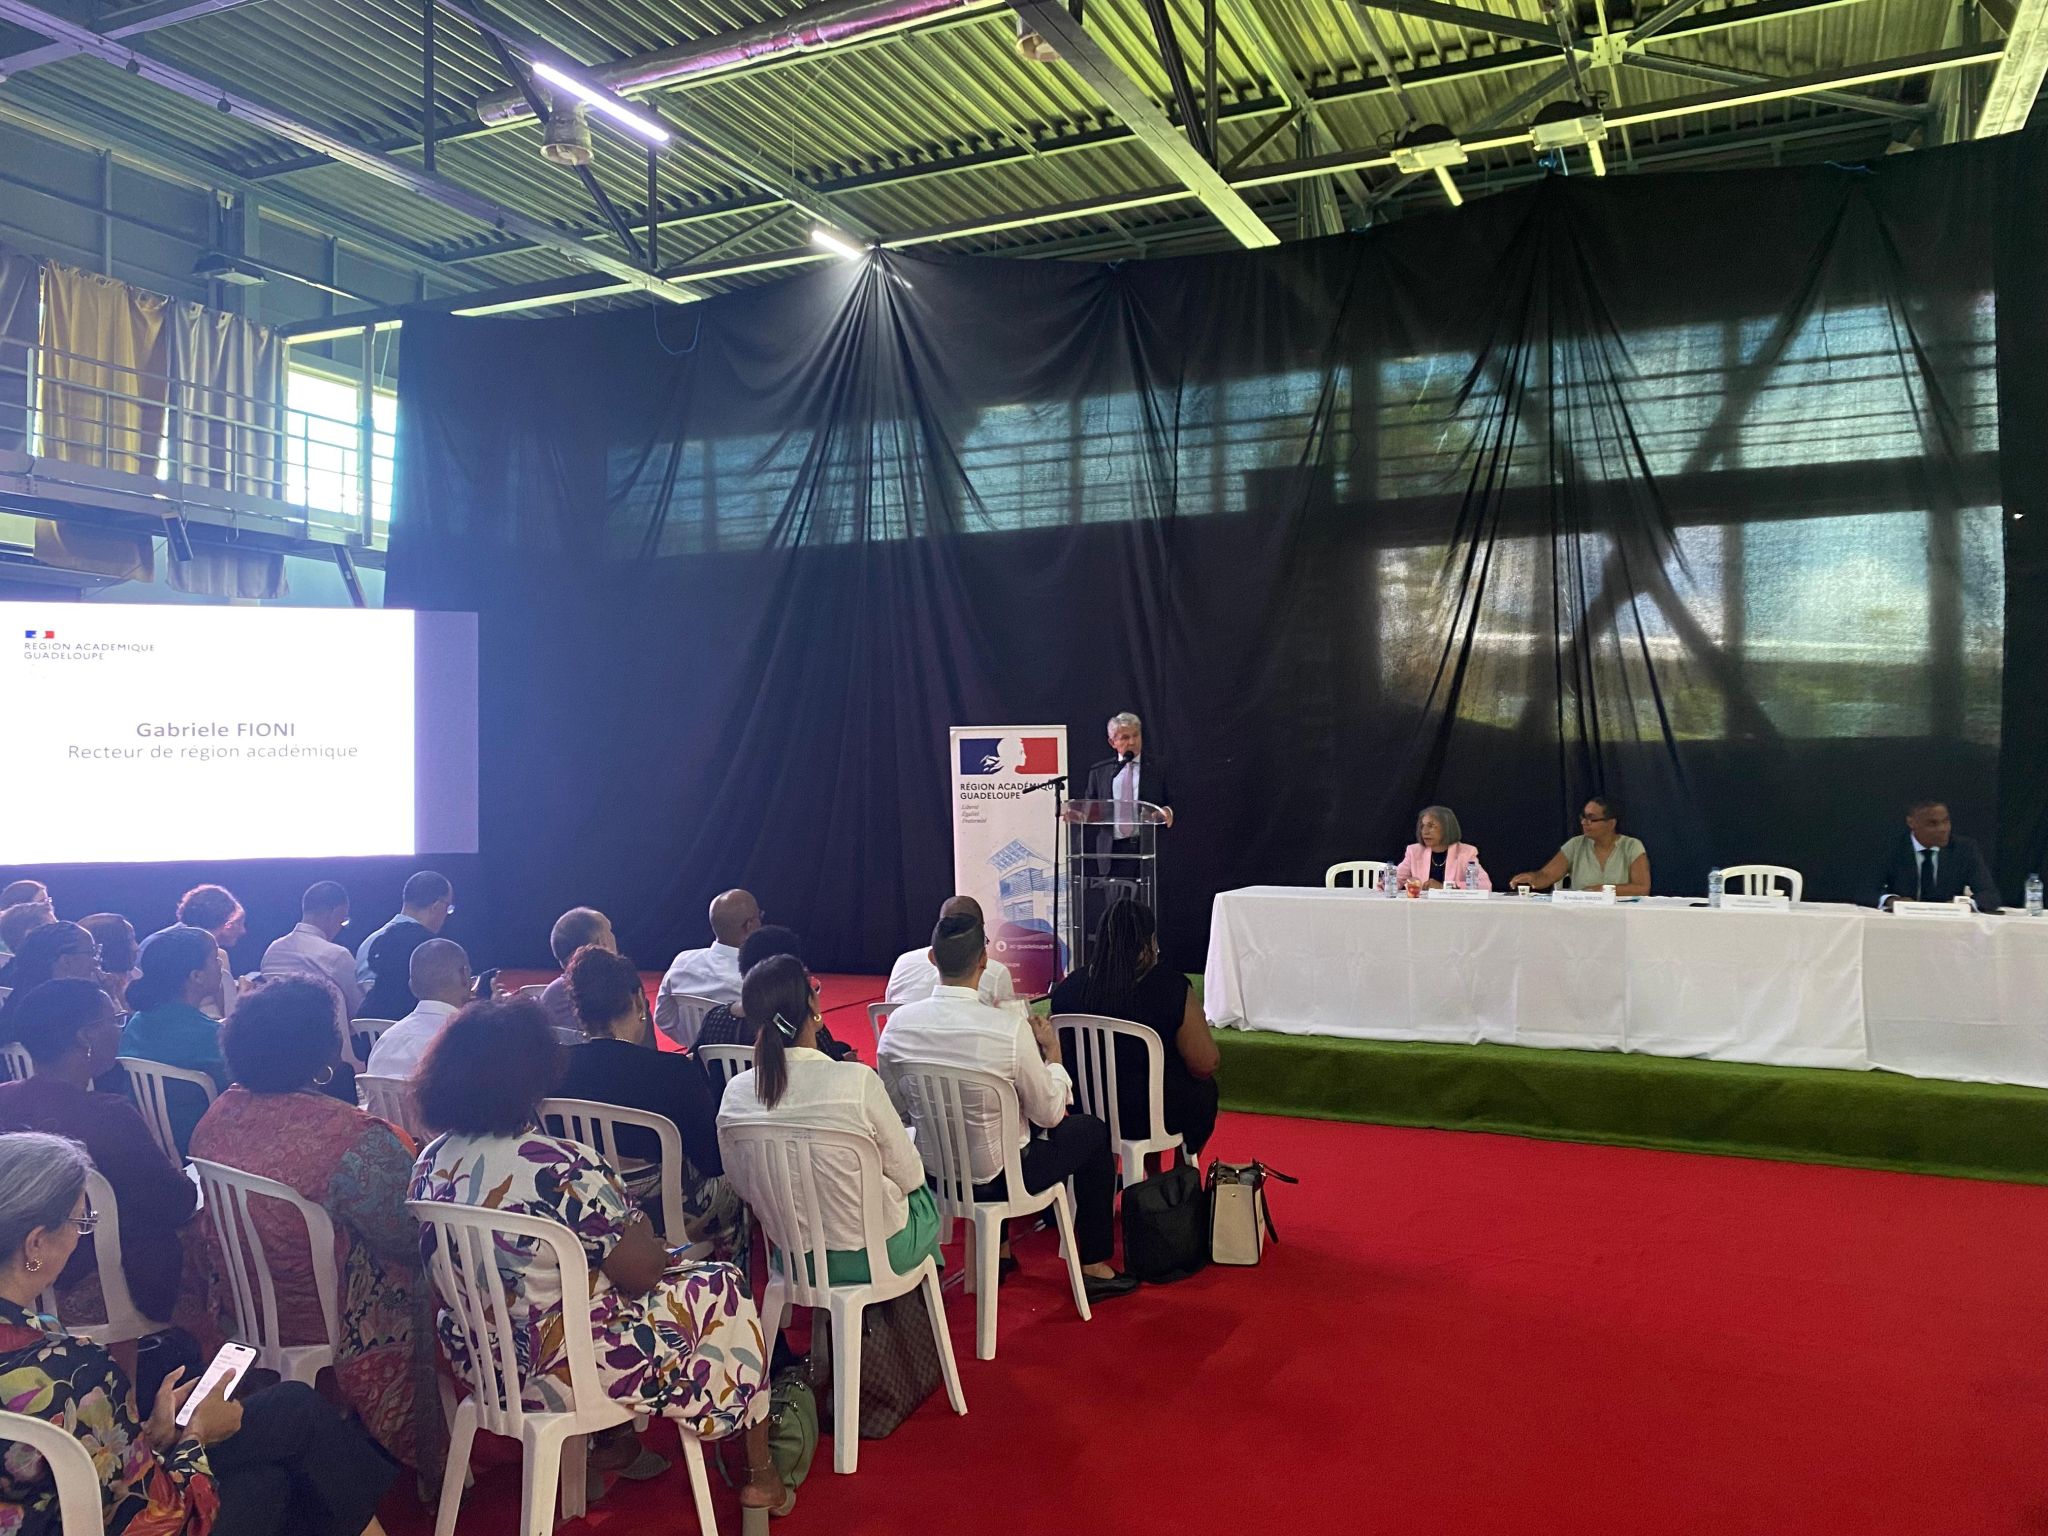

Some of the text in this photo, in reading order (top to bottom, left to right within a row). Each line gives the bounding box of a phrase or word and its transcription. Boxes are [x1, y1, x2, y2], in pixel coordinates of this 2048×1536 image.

[24, 652, 104, 660] GUADELOUPE
[136, 722, 295, 737] Gabriele FIONI
[68, 744, 358, 761] Recteur de région académique
[960, 782, 995, 791] RÉGION
[960, 792, 1020, 800] GUADELOUPE
